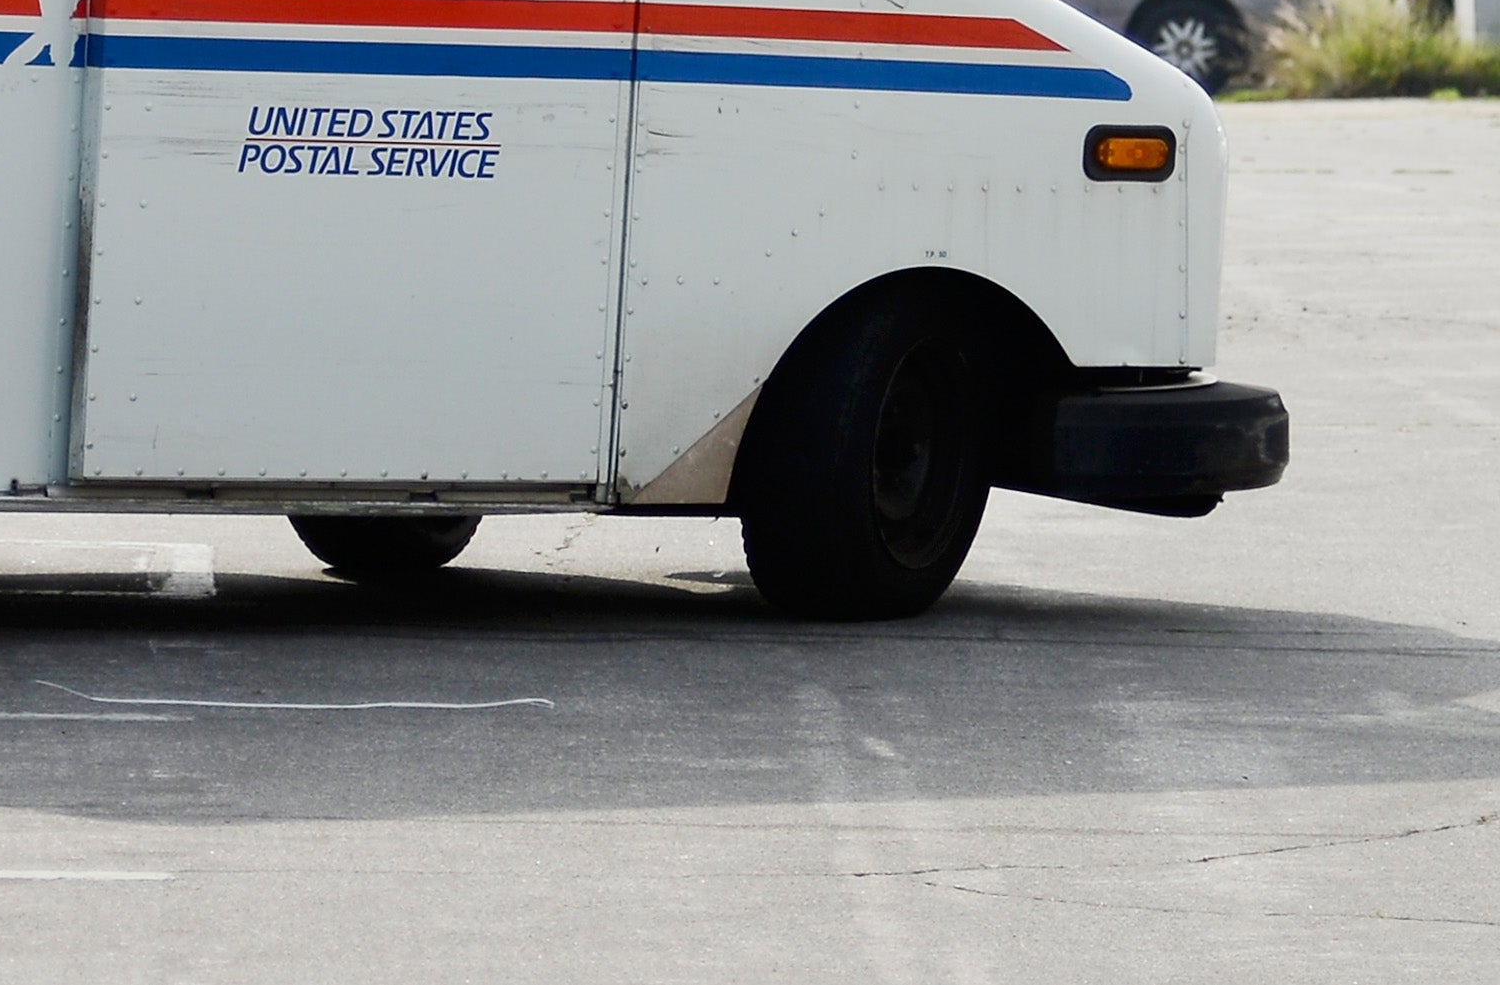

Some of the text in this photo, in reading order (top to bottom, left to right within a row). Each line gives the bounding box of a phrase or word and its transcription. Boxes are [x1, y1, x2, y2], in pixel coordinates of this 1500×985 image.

[248, 106, 493, 141] UNITED STATES
[238, 144, 500, 179] POSTAL SERVICE
